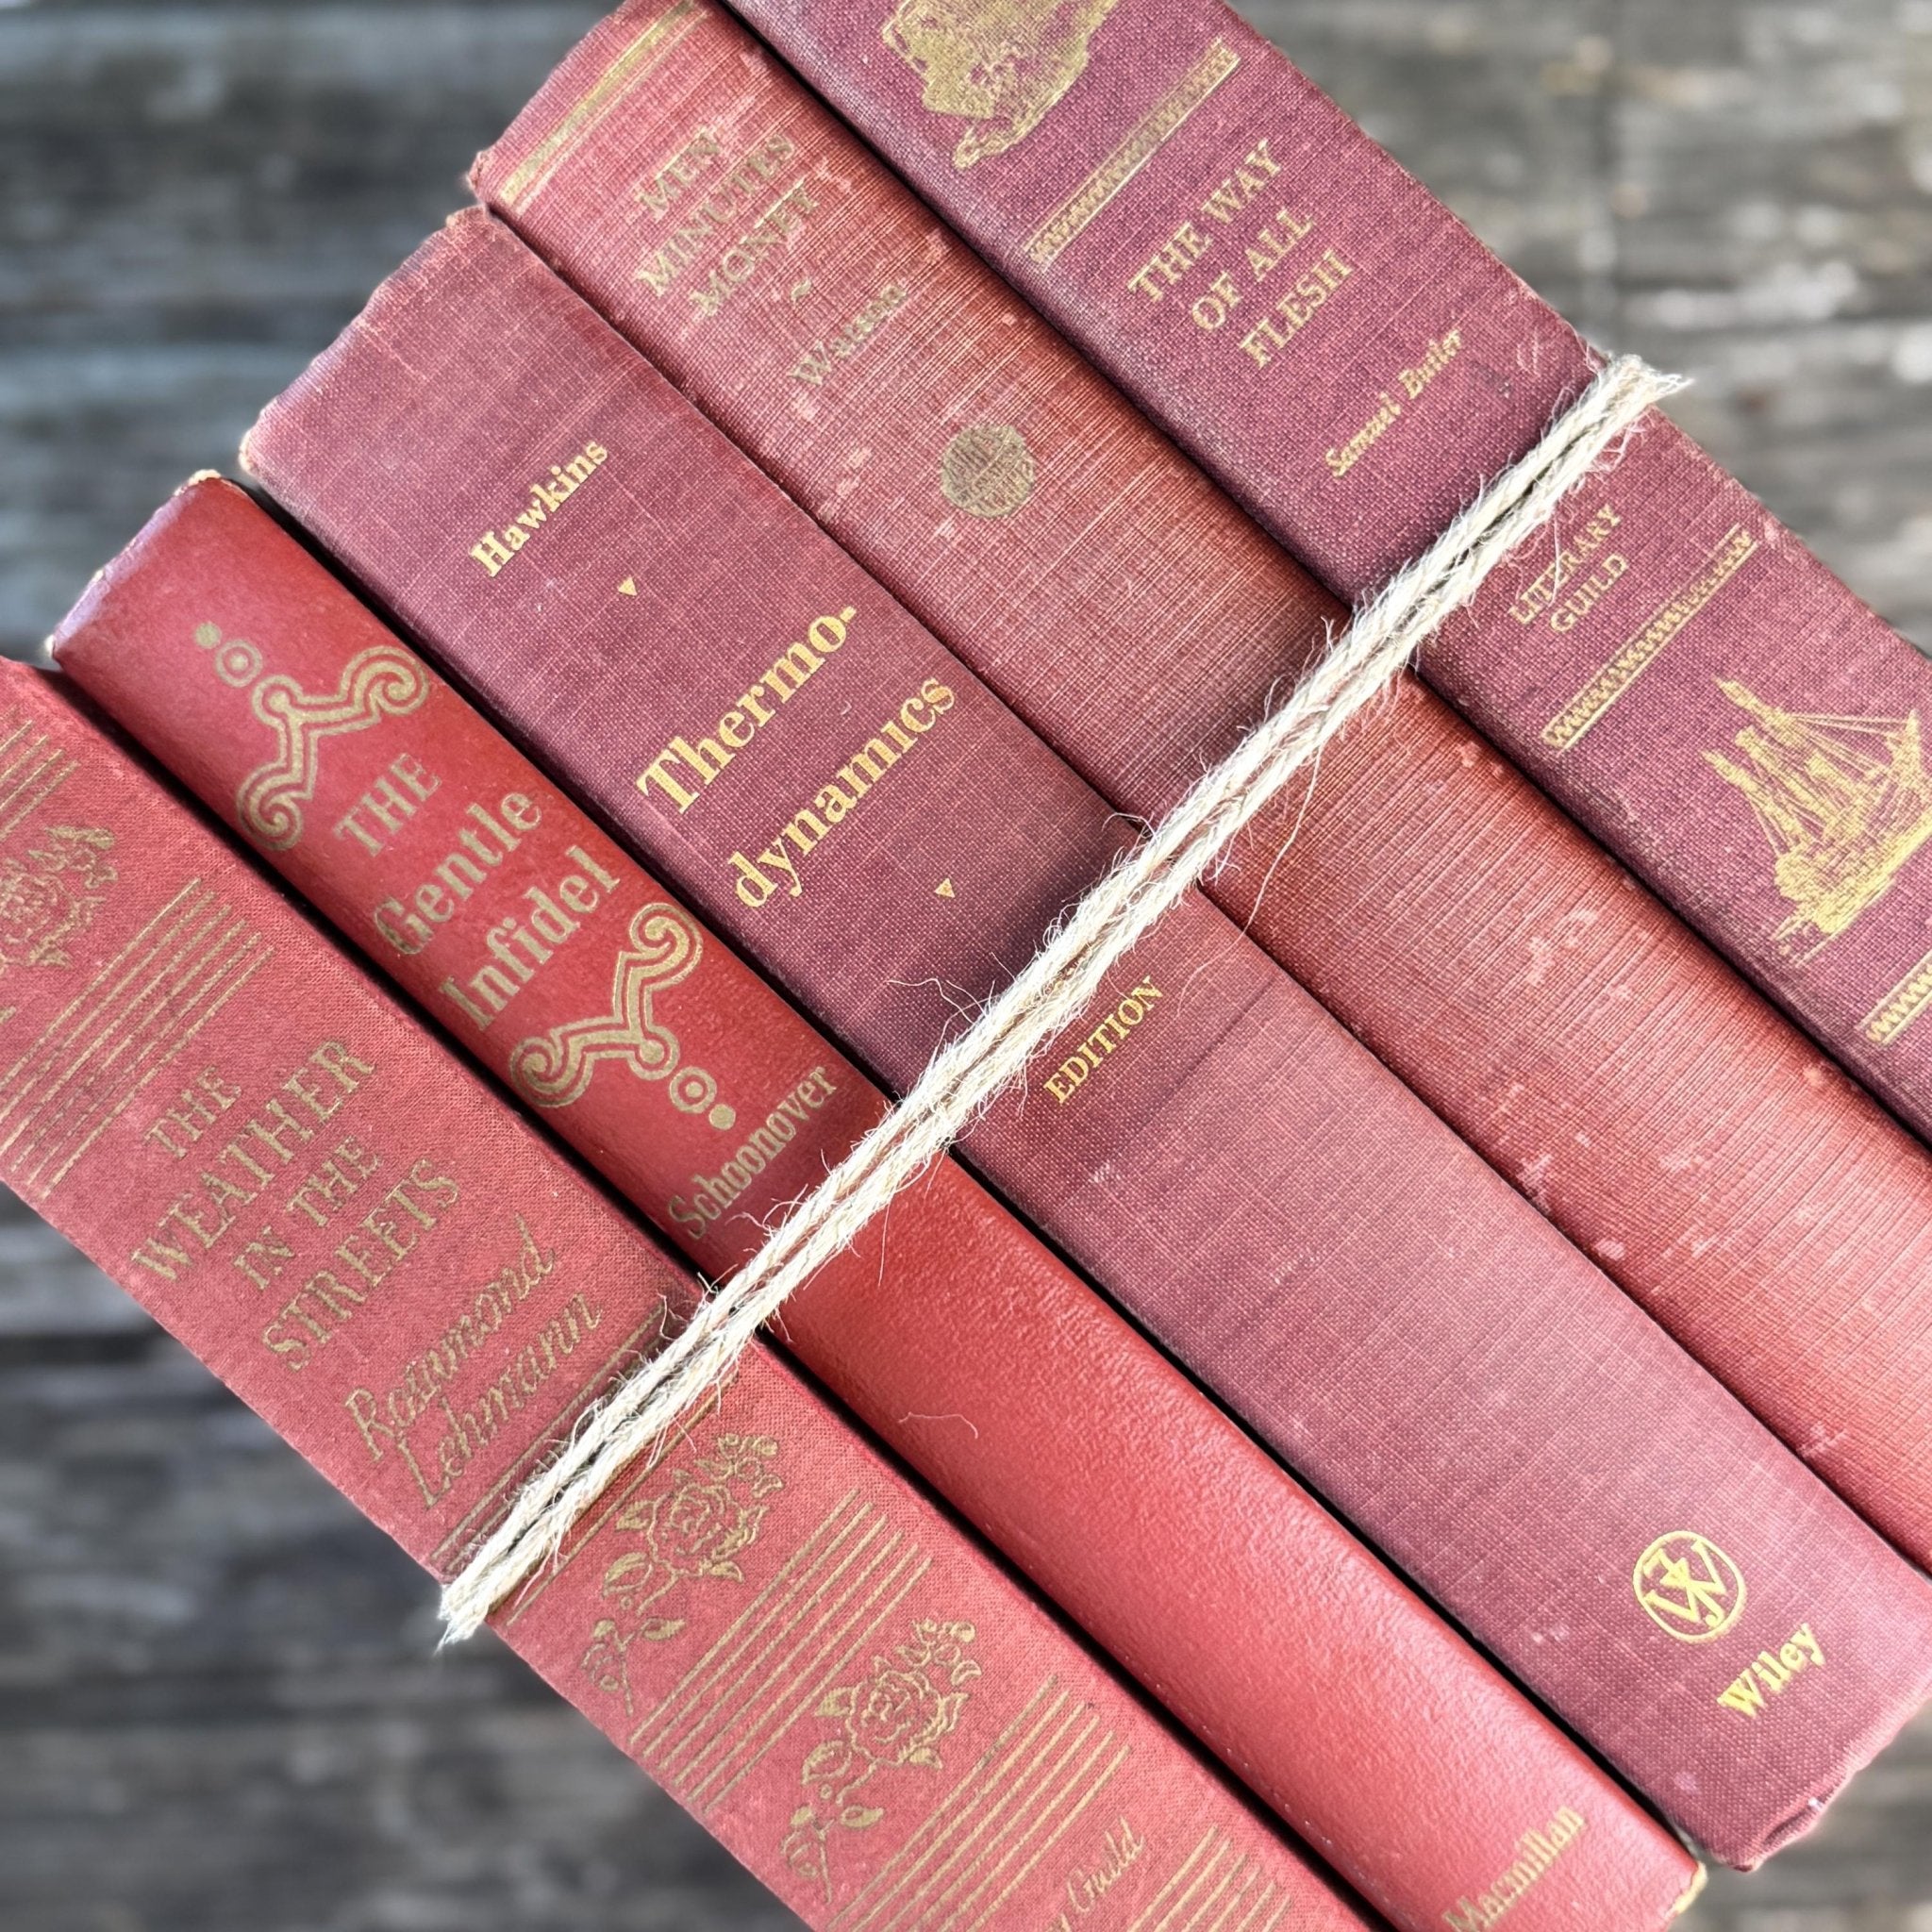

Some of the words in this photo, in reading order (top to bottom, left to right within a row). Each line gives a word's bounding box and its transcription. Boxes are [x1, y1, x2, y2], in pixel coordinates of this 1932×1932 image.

[634, 125, 720, 222] MEN
[637, 134, 795, 297] MINUTES
[1127, 221, 1213, 302] THE
[1201, 138, 1282, 224] WAY
[690, 177, 820, 317] MONEY
[1191, 271, 1241, 330] OF
[1244, 207, 1316, 282] ALL
[1240, 248, 1353, 369] FLESH
[1325, 391, 1401, 478] Samuel
[1398, 329, 1461, 400] Butler
[470, 441, 608, 577] Hawkins
[1507, 503, 1622, 625] LITERARY
[1550, 553, 1628, 632] GUILD
[636, 606, 857, 813] Thermo-
[334, 753, 442, 858] THE
[726, 676, 956, 908] dynamics
[372, 791, 542, 957] Gentle
[438, 845, 621, 1032] Infidel
[1042, 975, 1163, 1104] EDITION
[131, 1037, 376, 1282] WEATHER
[145, 1065, 242, 1159] THE
[669, 1066, 837, 1240] Schoonover
[234, 1225, 295, 1290] IN
[288, 1136, 382, 1227] THE
[261, 1158, 460, 1372] STREETS
[395, 1292, 604, 1508] Lehmann
[1717, 1623, 1825, 1718] Wiley
[1066, 1815, 1145, 1913] Guild
[1441, 1805, 1584, 1932] Macmillan
